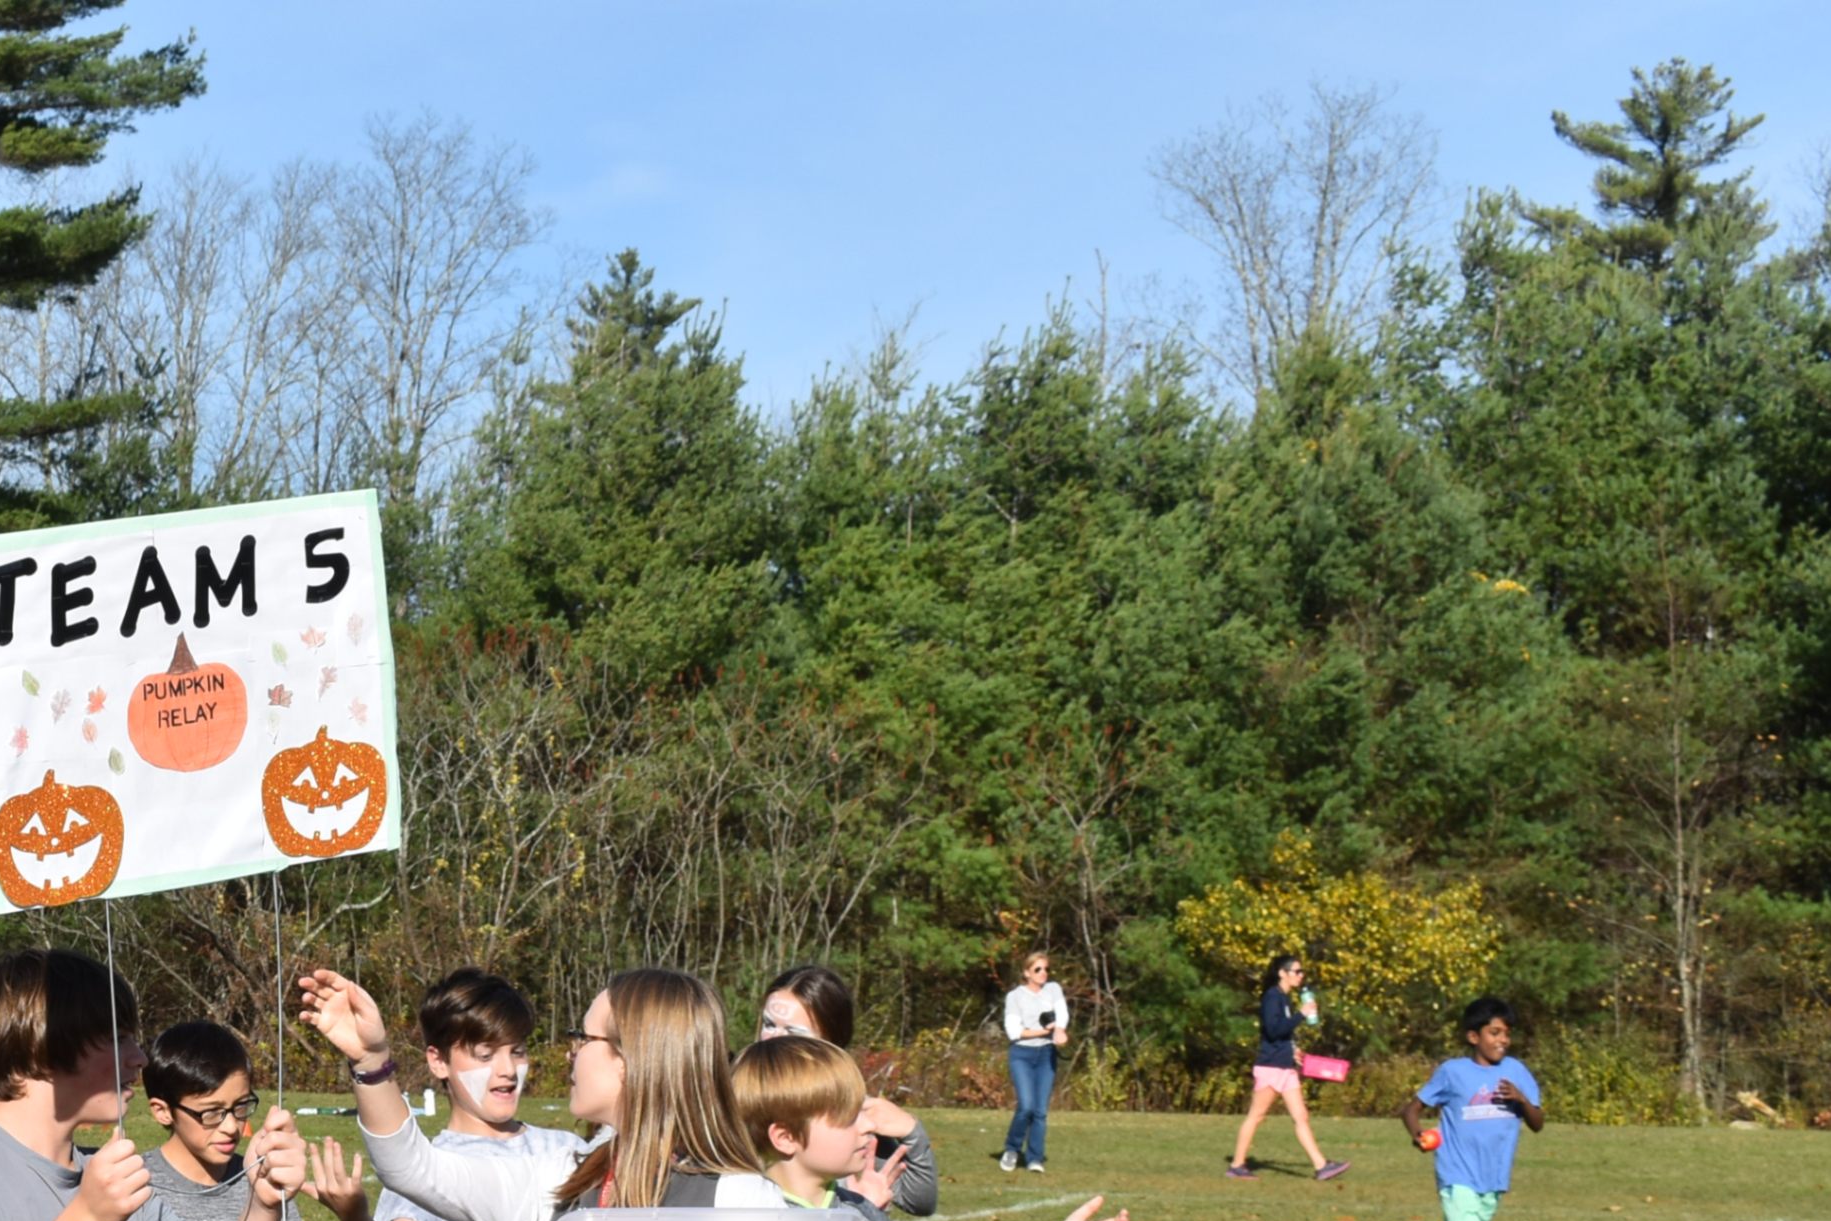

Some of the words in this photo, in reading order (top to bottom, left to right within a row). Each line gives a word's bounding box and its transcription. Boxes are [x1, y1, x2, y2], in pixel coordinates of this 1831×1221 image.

[304, 526, 351, 605] 5
[142, 672, 225, 702] PUMPKIN
[157, 701, 218, 729] RELAY
